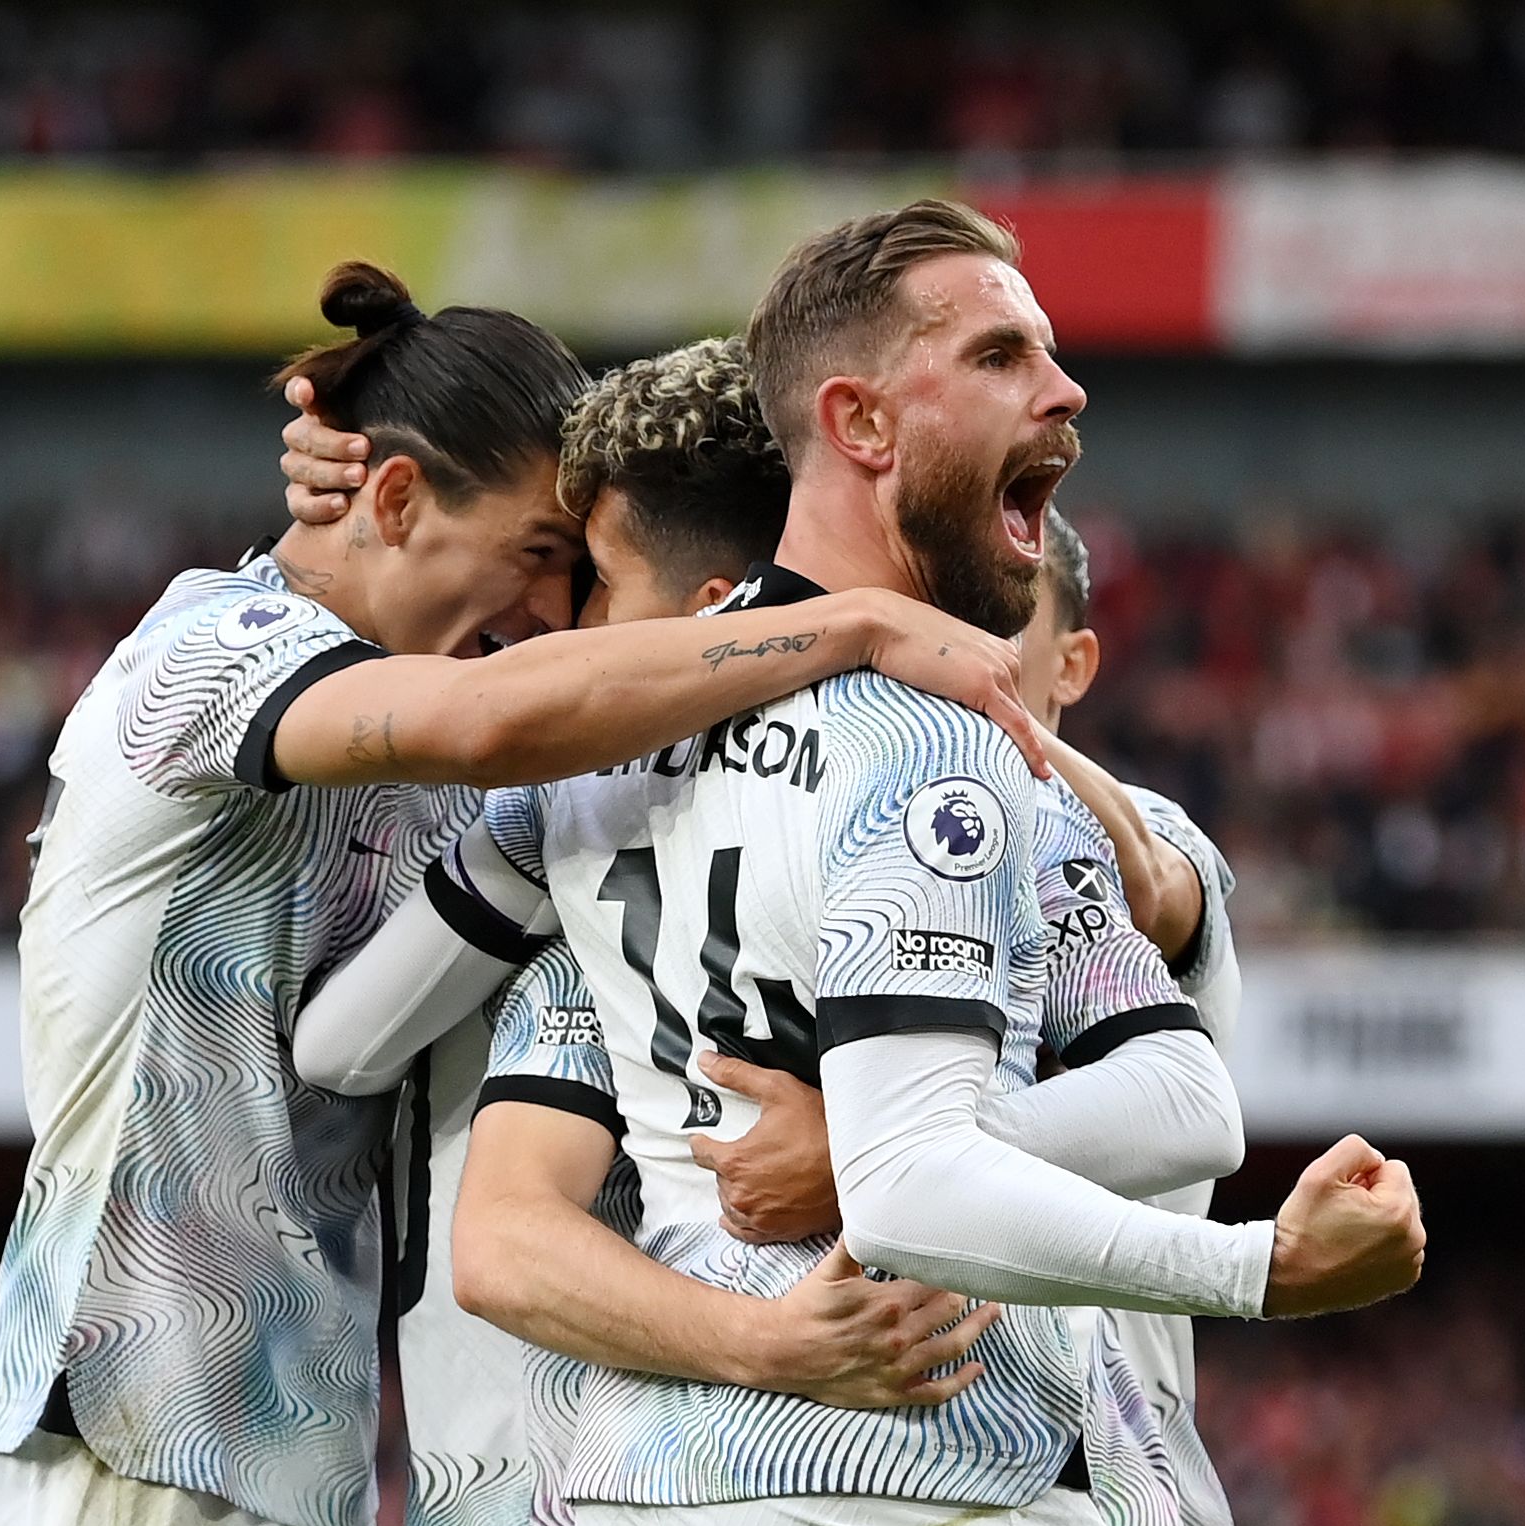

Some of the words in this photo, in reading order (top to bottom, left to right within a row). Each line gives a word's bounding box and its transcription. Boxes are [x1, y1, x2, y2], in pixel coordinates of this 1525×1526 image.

[954, 856, 986, 872] Premier
[984, 828, 1000, 860] League
[892, 930, 927, 952] No
[929, 936, 987, 962] room
[892, 948, 926, 971] for
[929, 954, 993, 983] racism
[597, 846, 820, 1128] 14
[535, 1025, 566, 1045] for
[538, 1007, 569, 1028] No
[571, 1011, 603, 1034] ro
